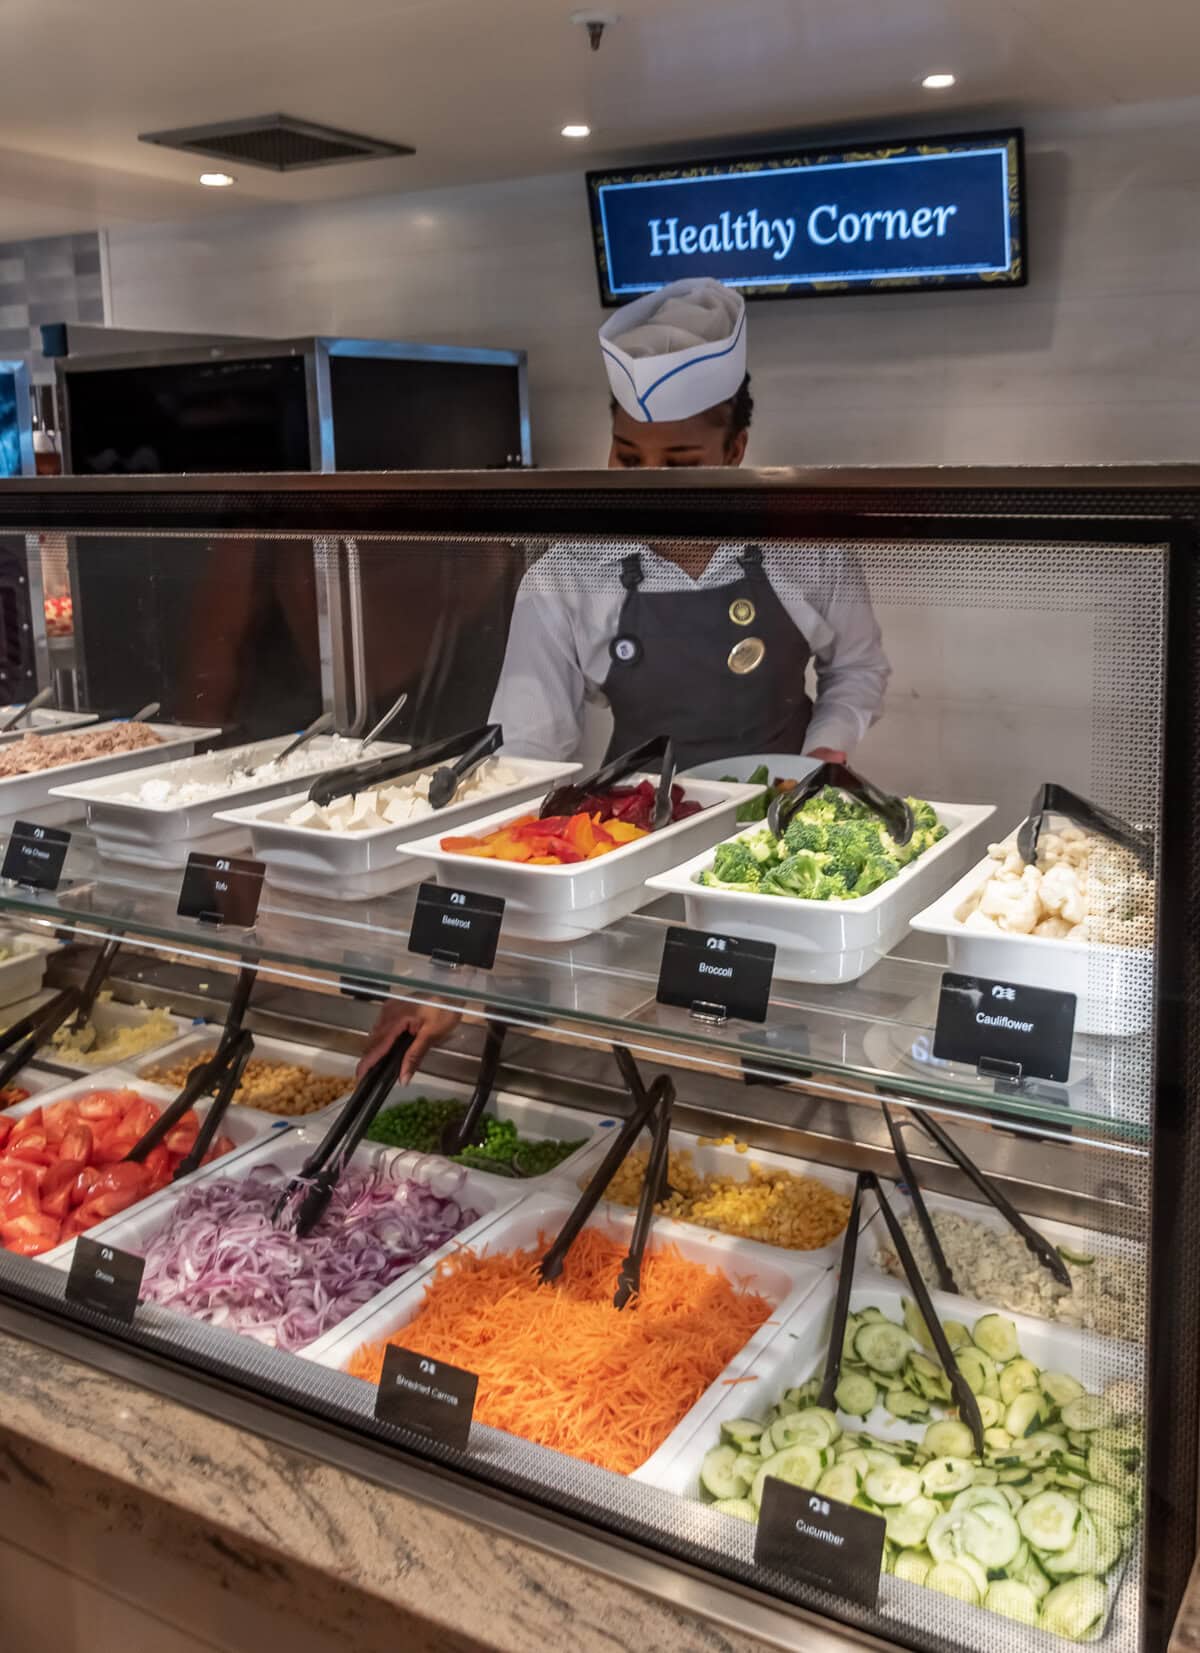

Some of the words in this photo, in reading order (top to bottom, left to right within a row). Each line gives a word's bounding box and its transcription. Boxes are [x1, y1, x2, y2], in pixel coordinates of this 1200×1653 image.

[648, 209, 795, 260] Healthy
[808, 204, 957, 246] Corner
[442, 914, 471, 929] Beetroot
[698, 962, 733, 977] Broccoli
[976, 1012, 1034, 1032] Cauliflower
[795, 1519, 844, 1546] Cucumber
